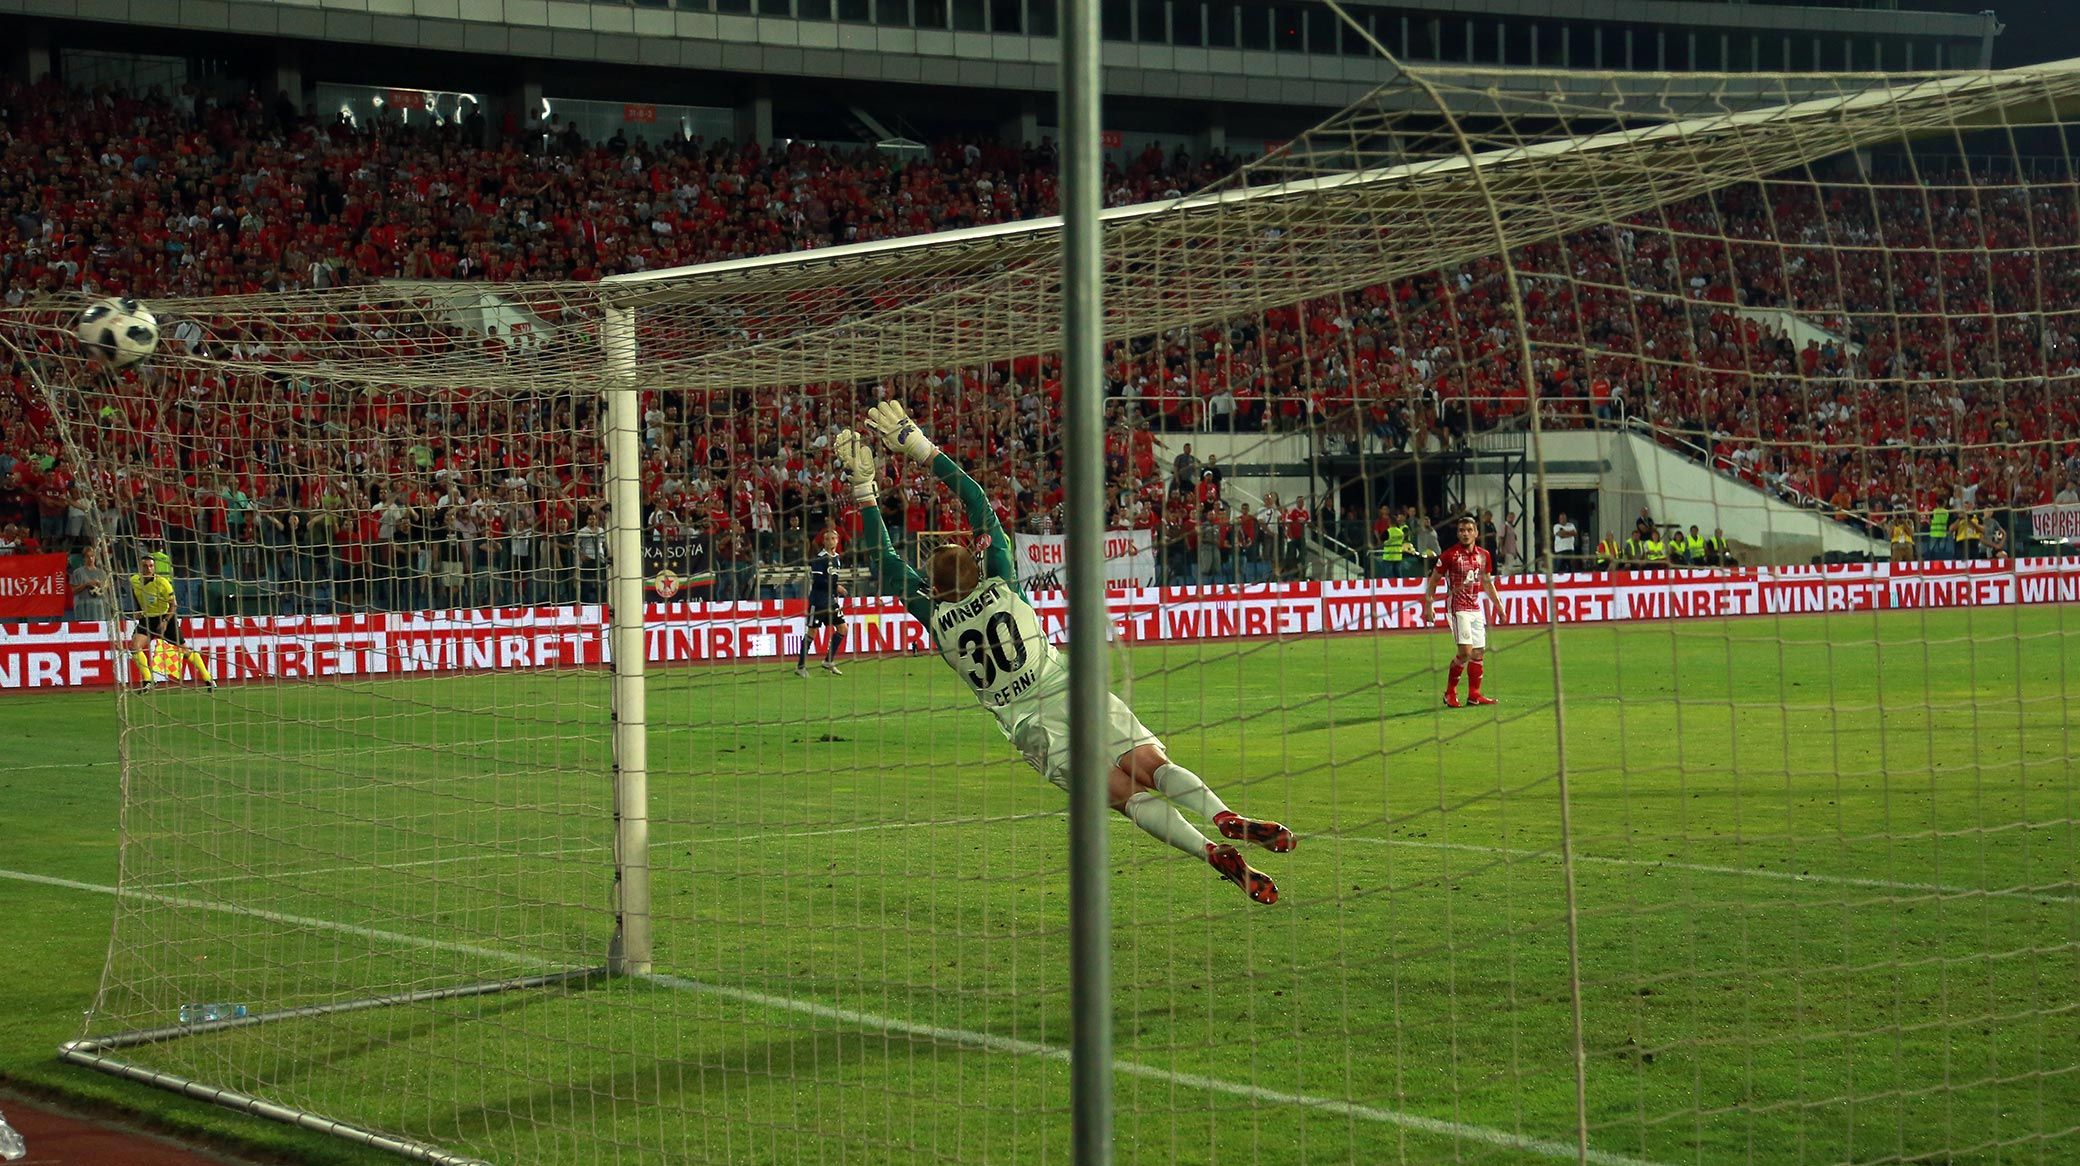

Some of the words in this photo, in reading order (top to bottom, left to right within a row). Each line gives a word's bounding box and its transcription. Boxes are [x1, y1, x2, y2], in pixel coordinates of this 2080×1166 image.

[643, 547, 663, 558] KA
[1028, 543, 1062, 564] ФЕН
[1104, 538, 1138, 558] ЛУБ
[2021, 576, 2080, 603] WIN
[938, 583, 1001, 632] WINBET
[645, 625, 792, 662] INBET
[958, 611, 1027, 689] 30
